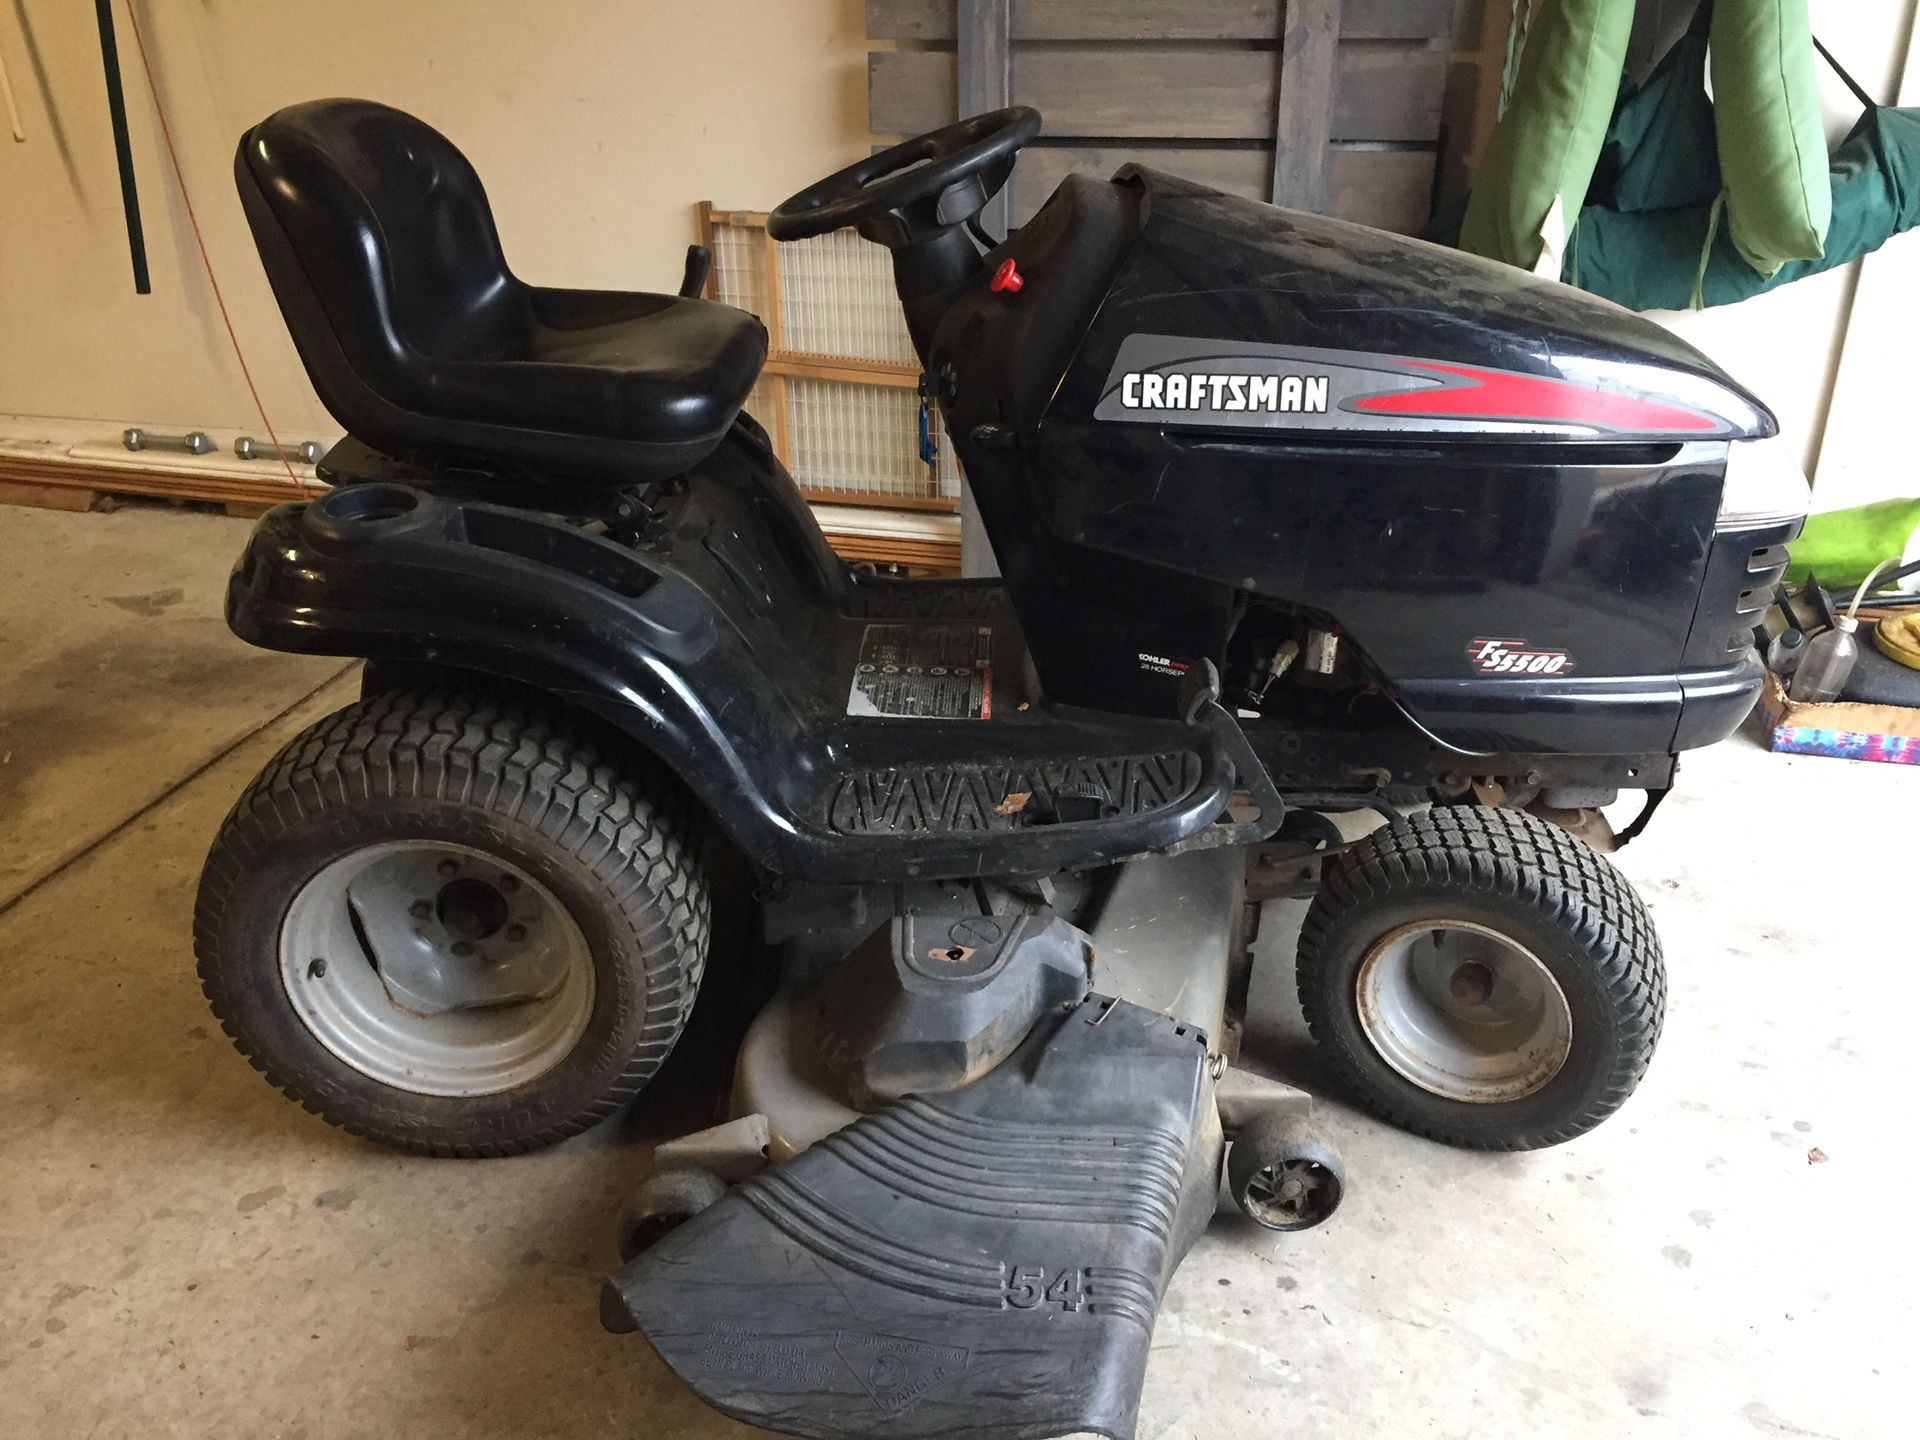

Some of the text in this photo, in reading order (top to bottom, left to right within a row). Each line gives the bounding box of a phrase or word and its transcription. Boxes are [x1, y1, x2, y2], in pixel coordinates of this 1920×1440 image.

[1121, 372, 1329, 413] CRAFTSMAN
[1476, 640, 1567, 674] FS5500
[1006, 1264, 1085, 1313] 54
